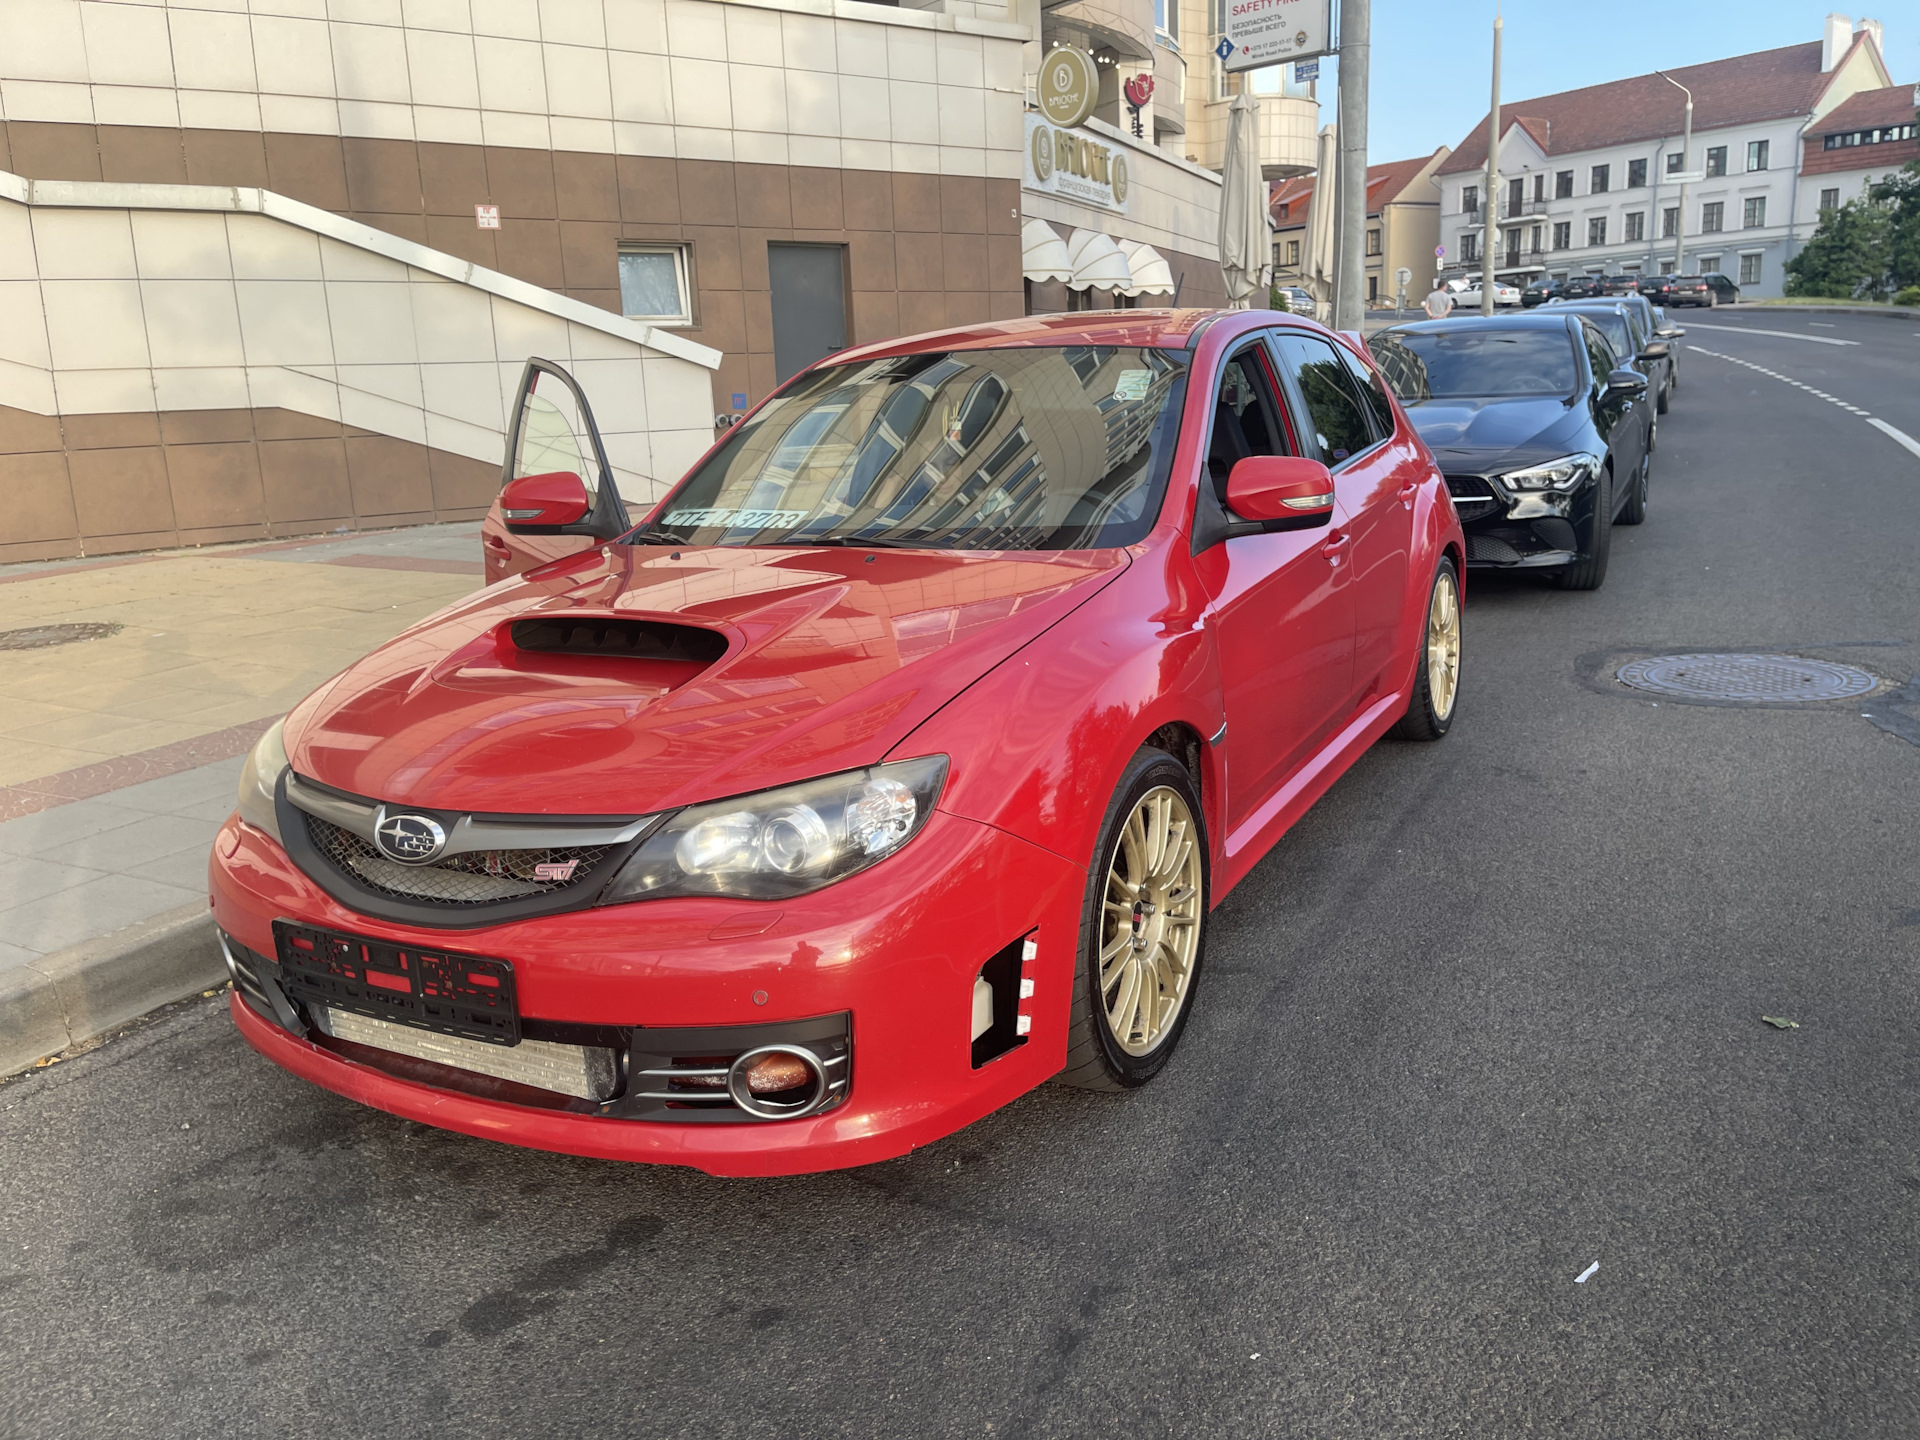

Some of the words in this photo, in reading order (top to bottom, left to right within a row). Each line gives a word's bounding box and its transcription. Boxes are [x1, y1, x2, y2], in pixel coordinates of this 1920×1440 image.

[1232, 0, 1272, 16] SAFETY
[1232, 14, 1282, 30] БЕЗОПАСНОСТЬ
[1232, 25, 1264, 38] ПРЕВЫШЕ
[1265, 21, 1286, 32] ВСЕГО
